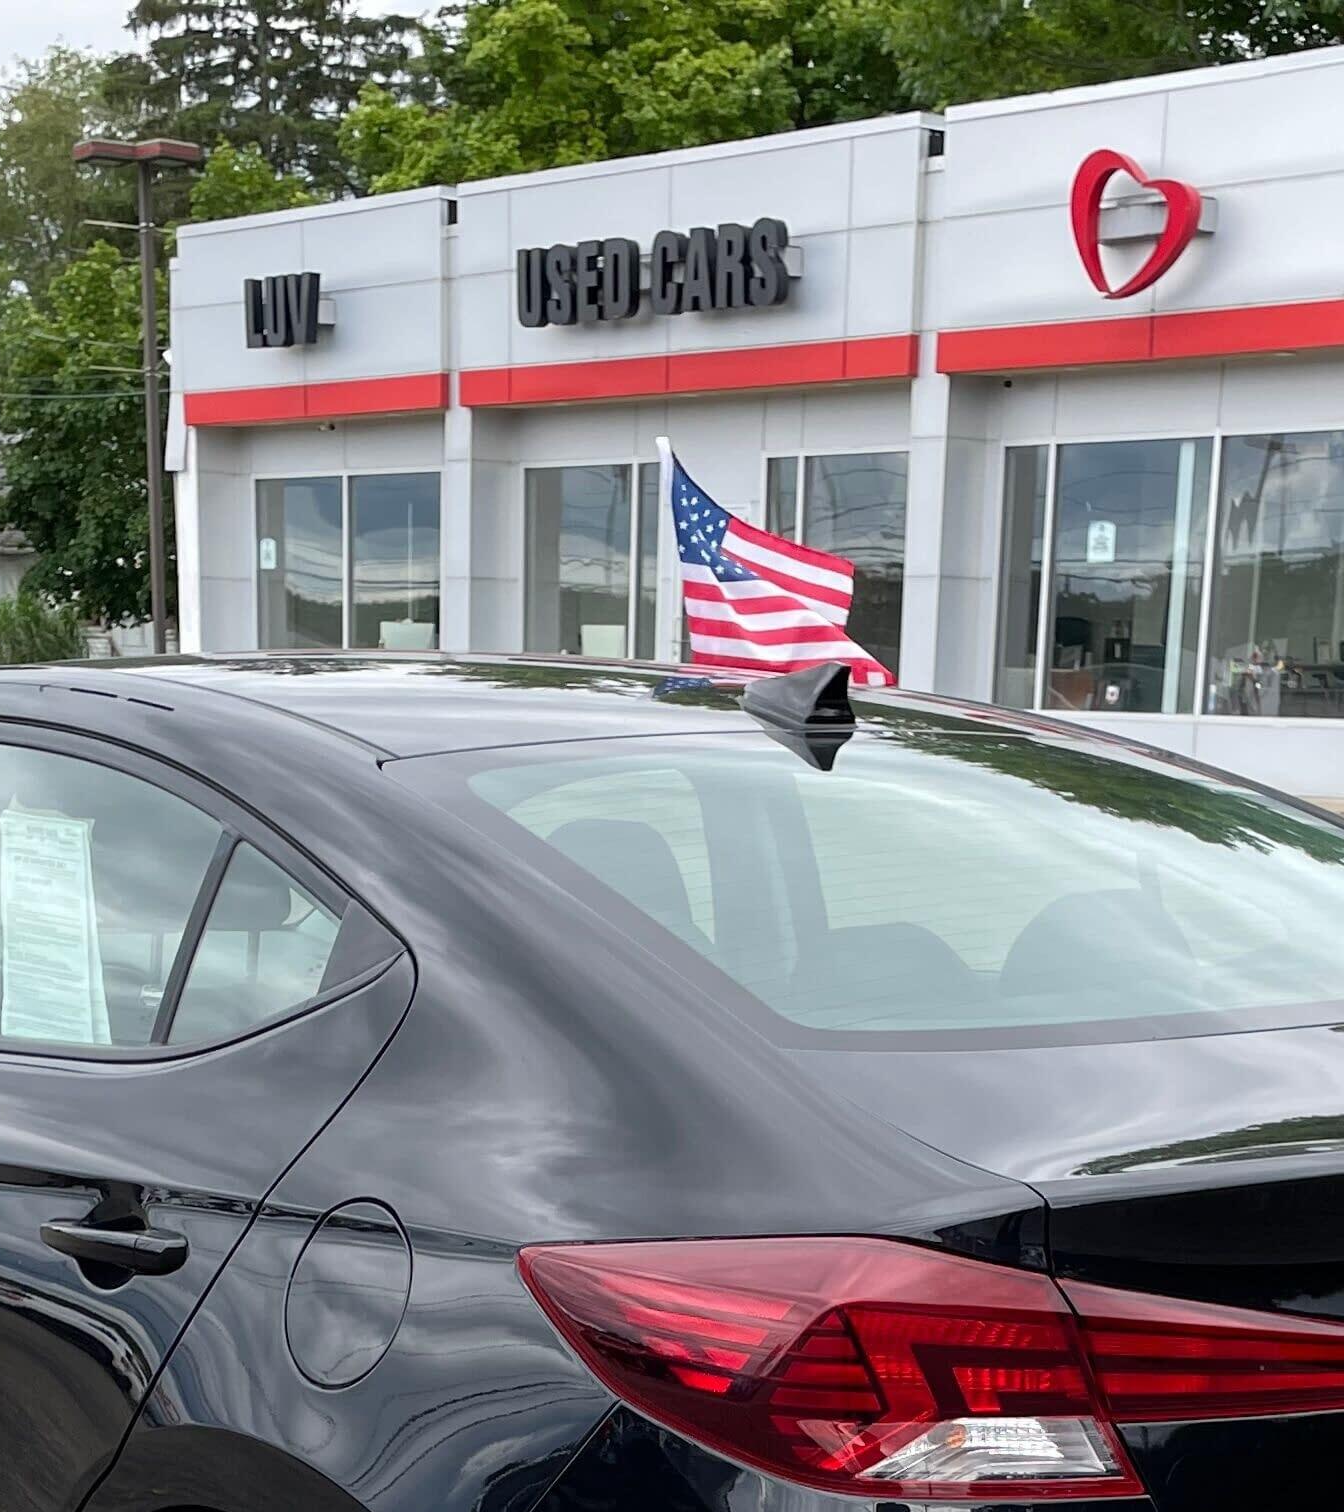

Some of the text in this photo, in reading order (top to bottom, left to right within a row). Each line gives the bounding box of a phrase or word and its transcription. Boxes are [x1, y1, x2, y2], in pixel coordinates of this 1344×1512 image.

[244, 272, 321, 348] LUV
[517, 217, 789, 328] USED CARS
